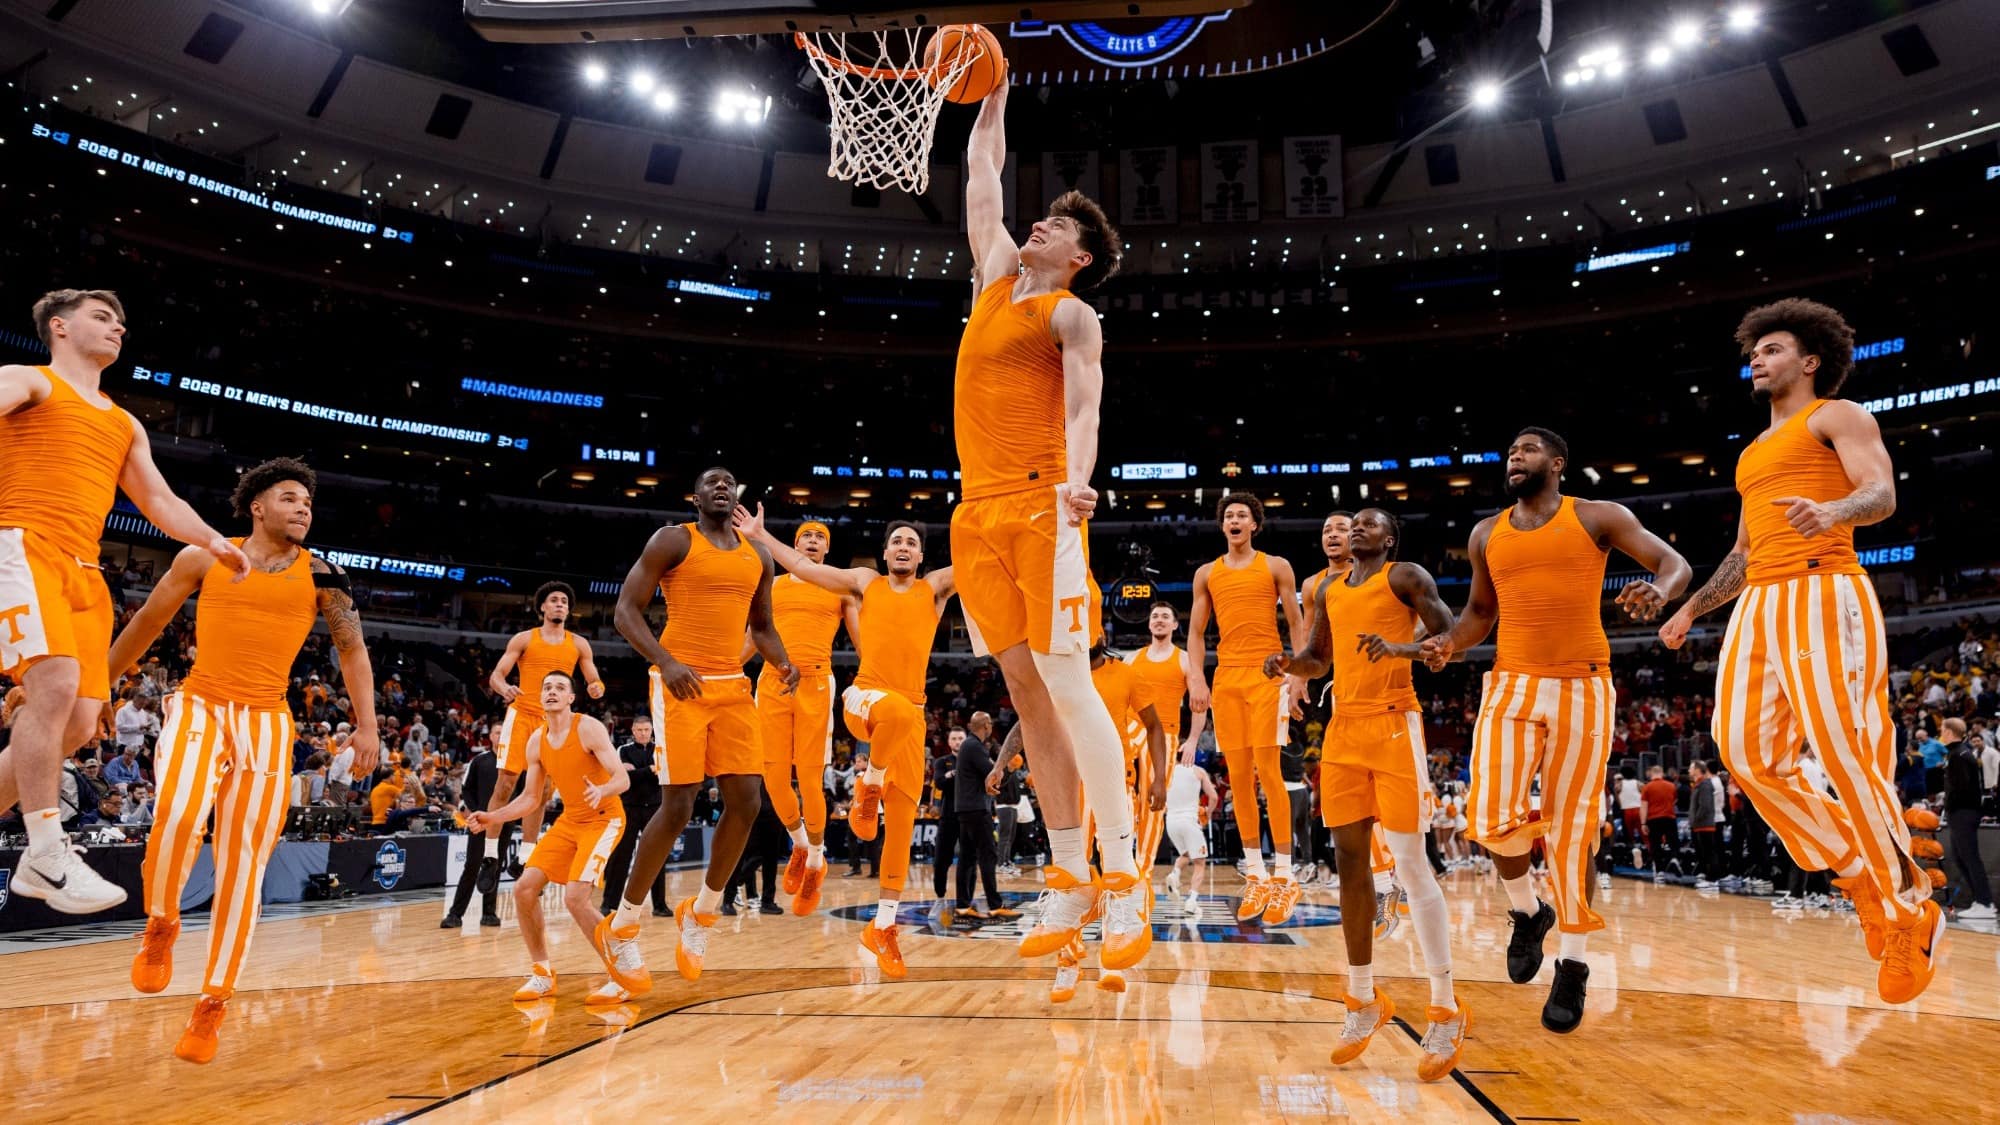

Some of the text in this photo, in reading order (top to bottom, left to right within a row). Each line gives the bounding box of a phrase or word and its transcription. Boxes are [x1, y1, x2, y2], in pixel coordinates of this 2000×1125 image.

[1107, 36, 1144, 52] ELITE
[78, 139, 376, 233] 2026 DI MEN'S BASKETBALL CHAMPIONSHIP
[461, 377, 604, 408] #MARCHMADNESS
[1897, 393, 1917, 408] DI
[1920, 384, 1970, 403] MEN'S
[180, 377, 490, 443] 2026 DI MEN'S BASKETBALL CHAMPIONSHIP
[595, 448, 641, 463] 9:19 PM
[1281, 464, 1308, 473] FOULS
[1321, 464, 1350, 472] BONUS
[326, 550, 447, 581] SWEET SIXTEEN
[1122, 585, 1151, 598] 12:39
[0, 604, 30, 644] T
[1060, 595, 1084, 632] T
[188, 731, 202, 741] T
[593, 855, 606, 874] T
